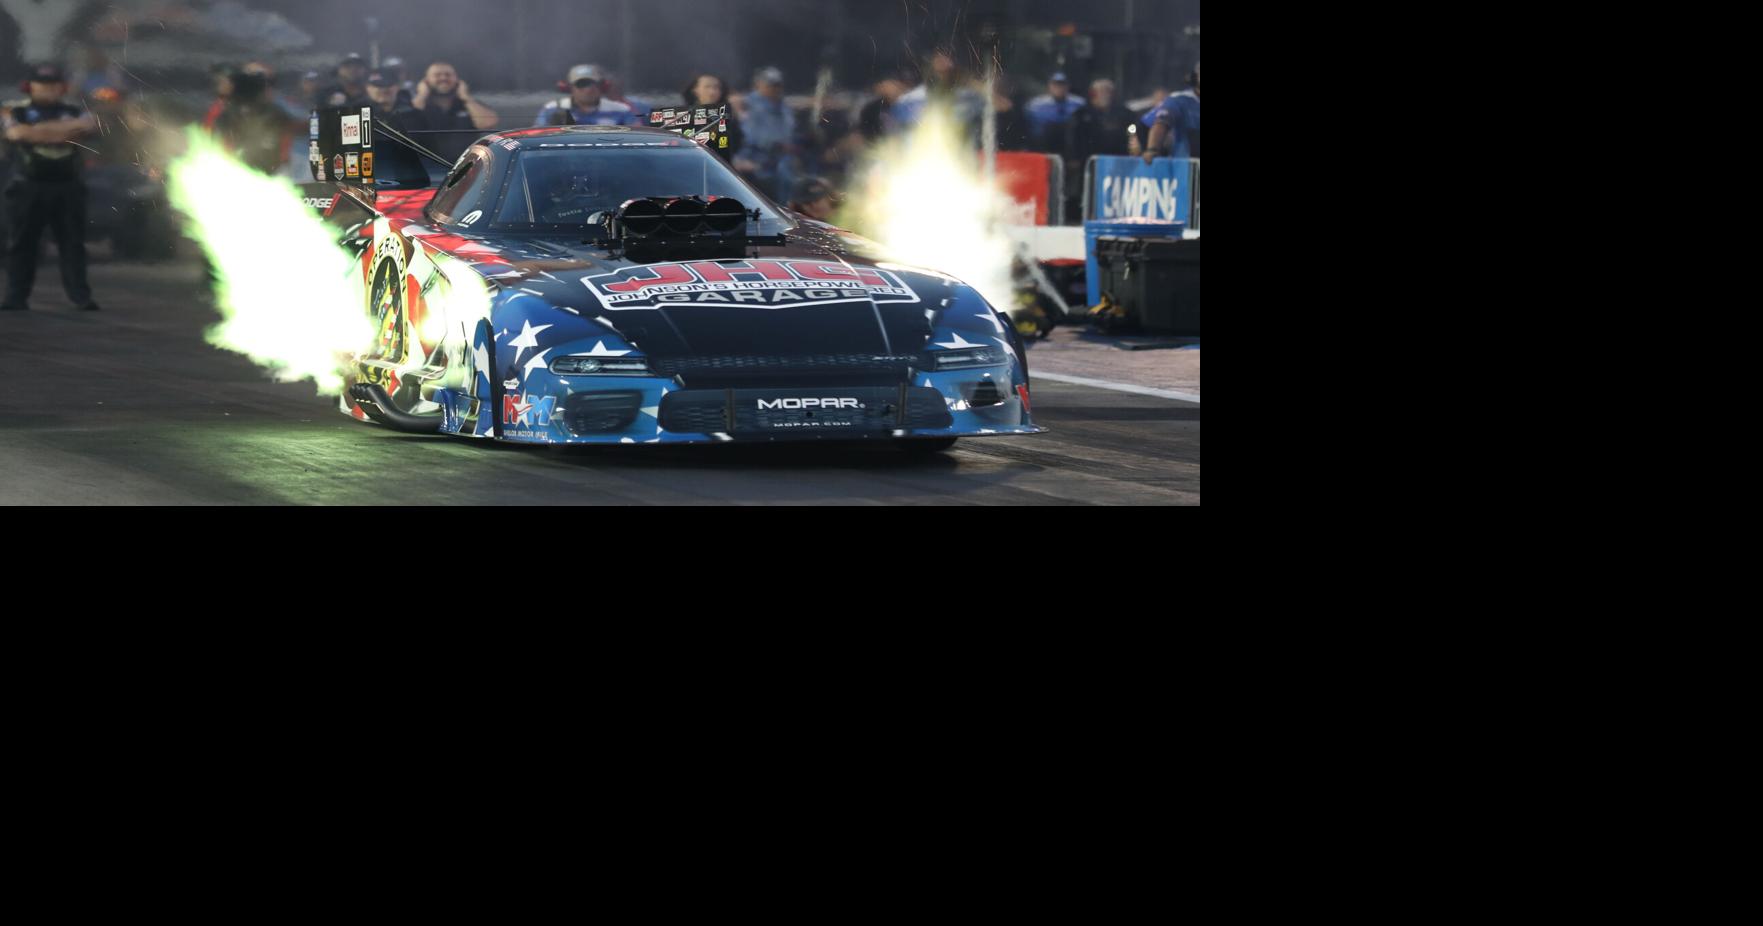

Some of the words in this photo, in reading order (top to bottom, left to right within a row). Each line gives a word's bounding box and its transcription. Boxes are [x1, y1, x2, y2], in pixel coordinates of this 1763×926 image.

[1103, 175, 1178, 221] CAMPING
[367, 237, 407, 294] OPERATION
[603, 261, 889, 293] JHG
[607, 283, 726, 303] JOHNSON'S
[733, 280, 906, 295] HORSEPOWERED
[657, 288, 873, 303] GARAGE
